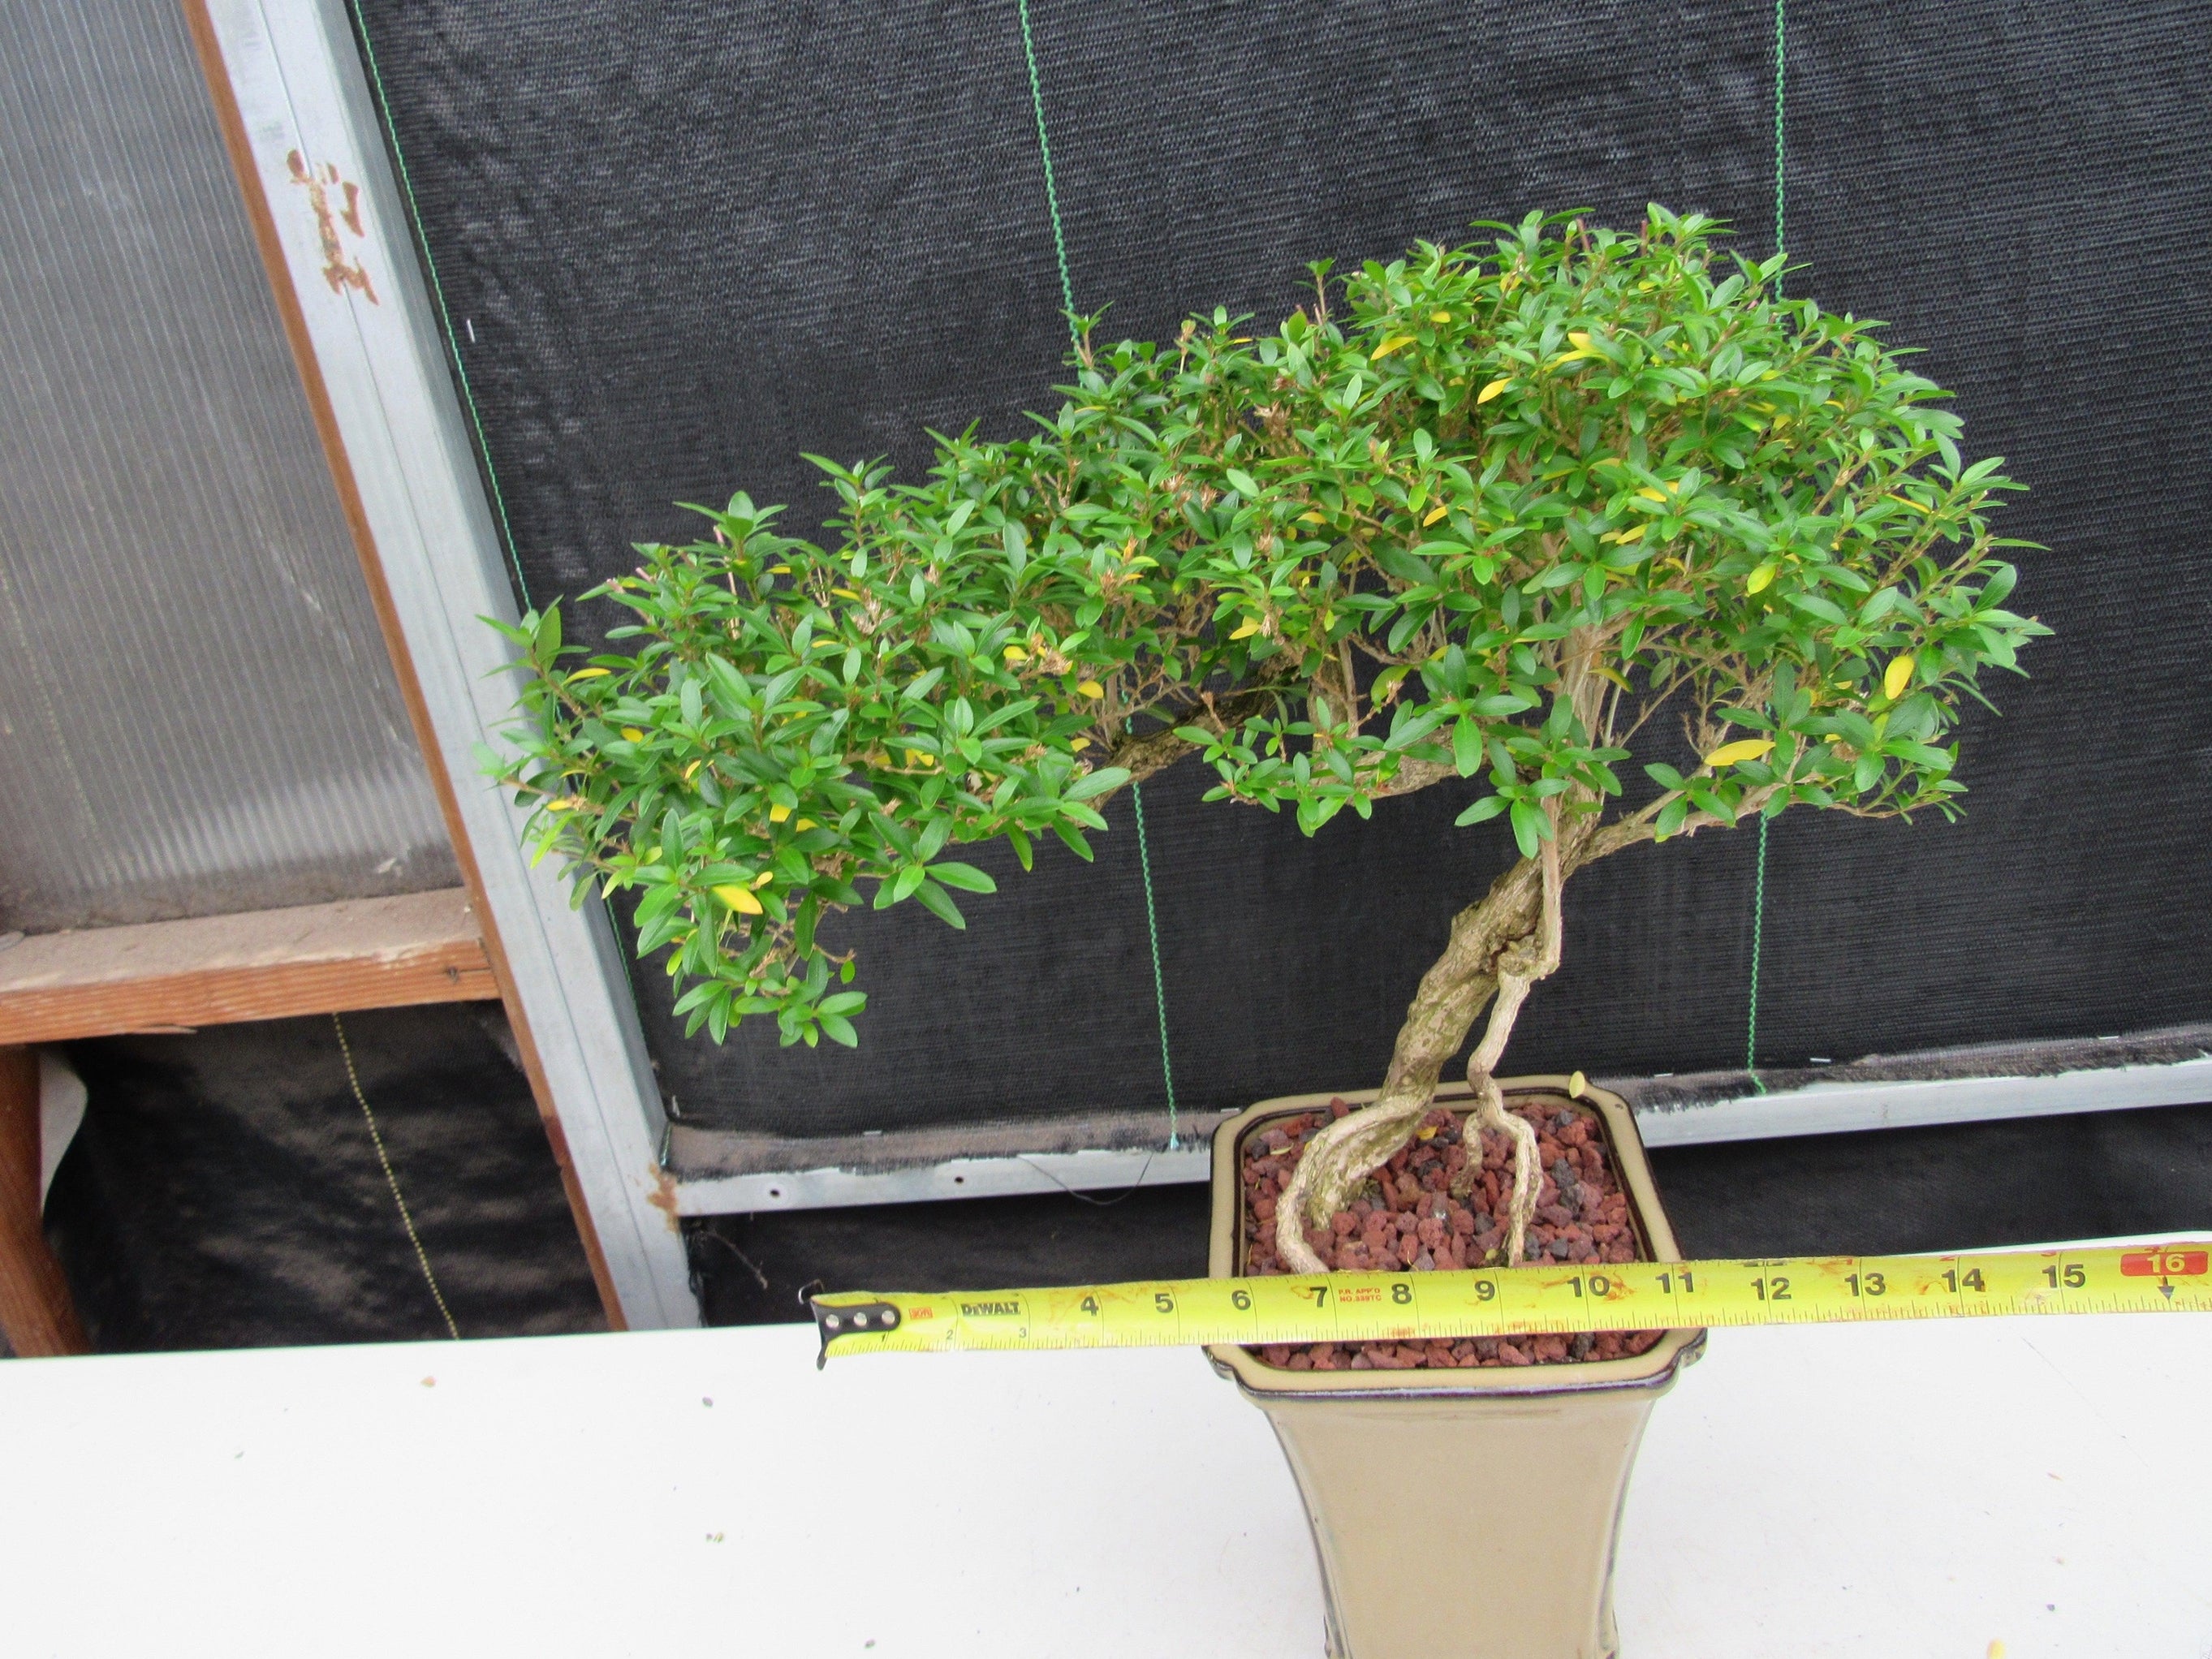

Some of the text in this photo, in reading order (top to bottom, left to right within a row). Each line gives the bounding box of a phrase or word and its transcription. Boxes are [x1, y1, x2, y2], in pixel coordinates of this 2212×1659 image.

[1080, 1253, 2185, 1316] 4 5 6 7 8 9 10 11 12 13 14 15 16
[946, 1329, 954, 1339] 2
[1019, 1328, 1027, 1338] 3
